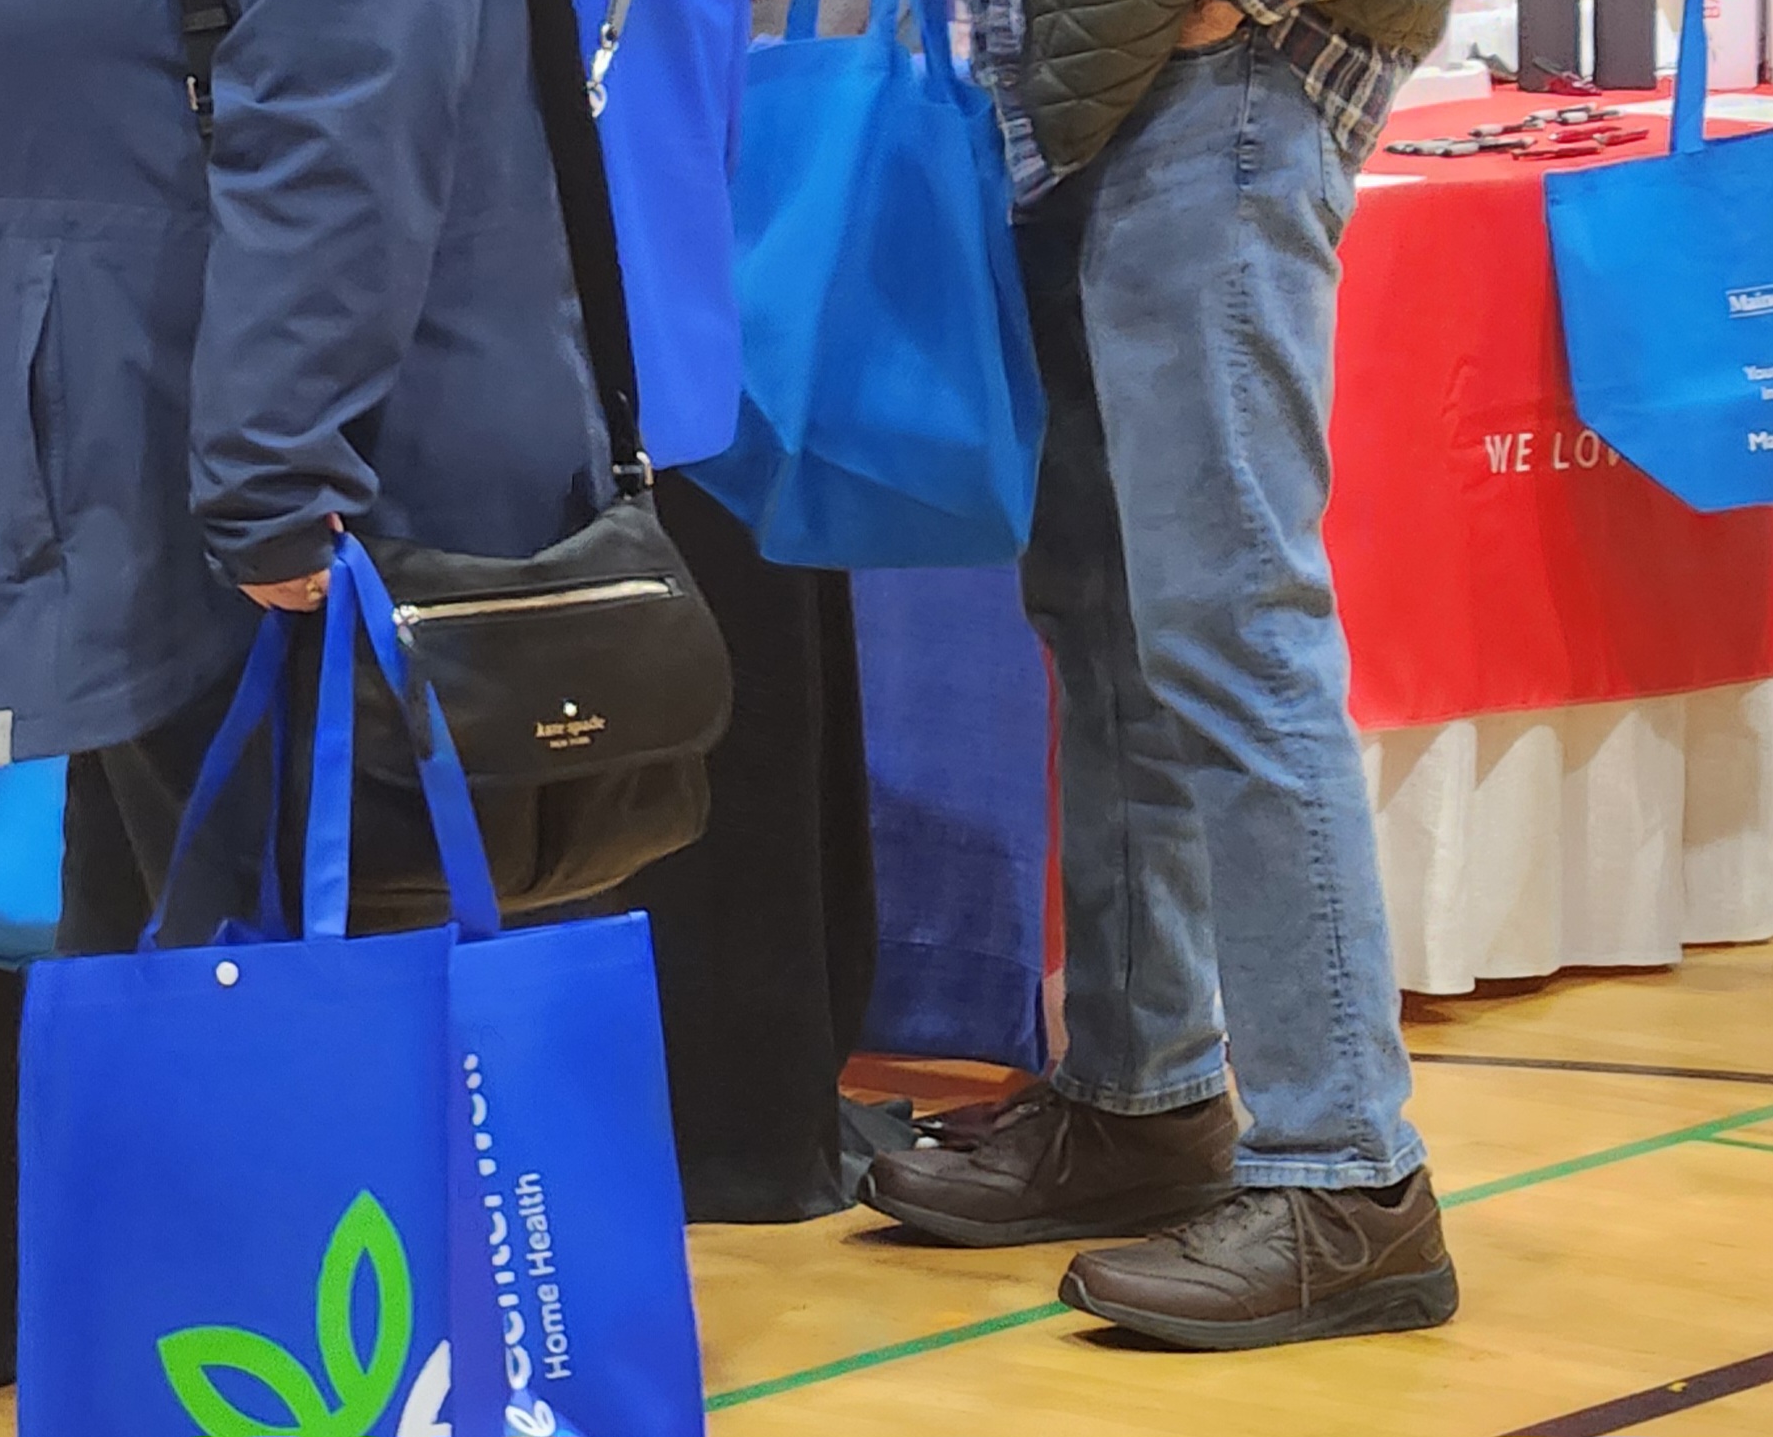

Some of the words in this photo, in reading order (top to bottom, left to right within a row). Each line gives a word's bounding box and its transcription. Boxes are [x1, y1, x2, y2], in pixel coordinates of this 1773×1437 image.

[1485, 432, 1534, 474] WE
[515, 1171, 556, 1277] Health
[537, 1283, 572, 1381] Home
